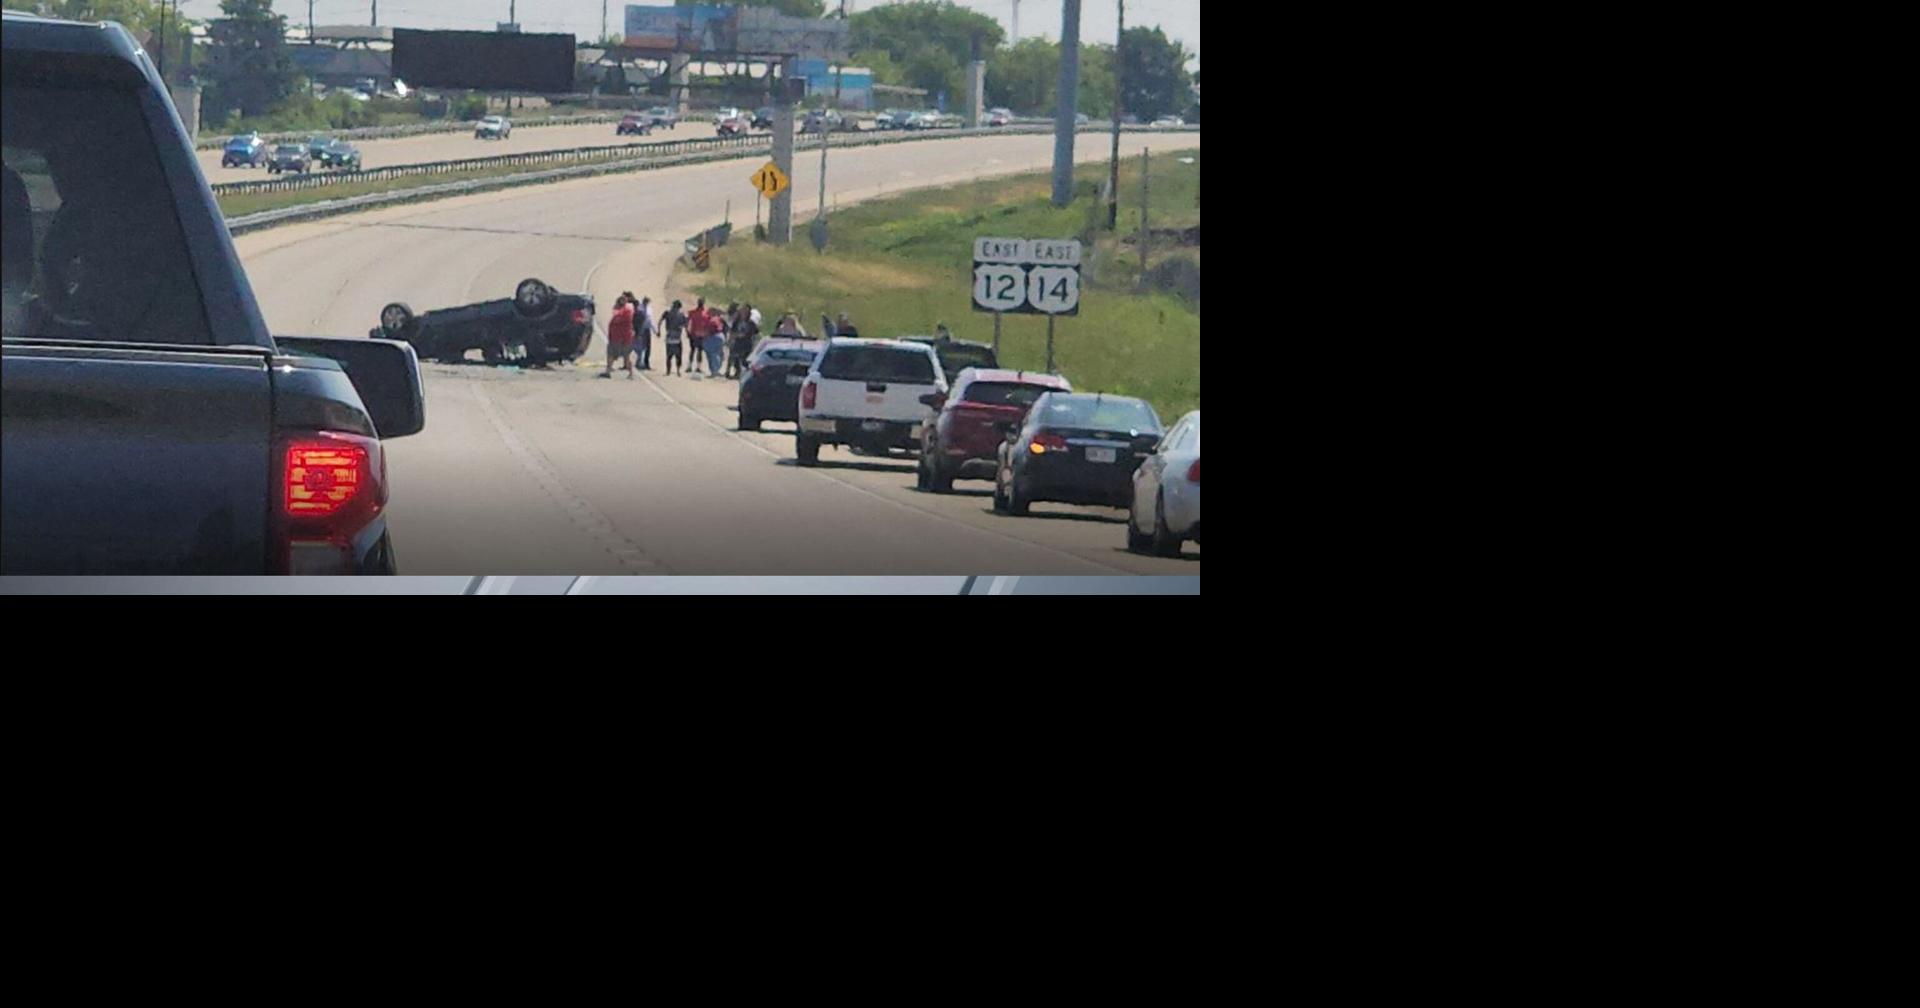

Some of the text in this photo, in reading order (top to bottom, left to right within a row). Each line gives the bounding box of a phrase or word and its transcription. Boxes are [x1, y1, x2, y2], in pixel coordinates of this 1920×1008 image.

[982, 241, 1018, 257] EAST
[1035, 243, 1073, 259] EAST
[985, 274, 1015, 300] 12
[1038, 276, 1069, 302] 14
